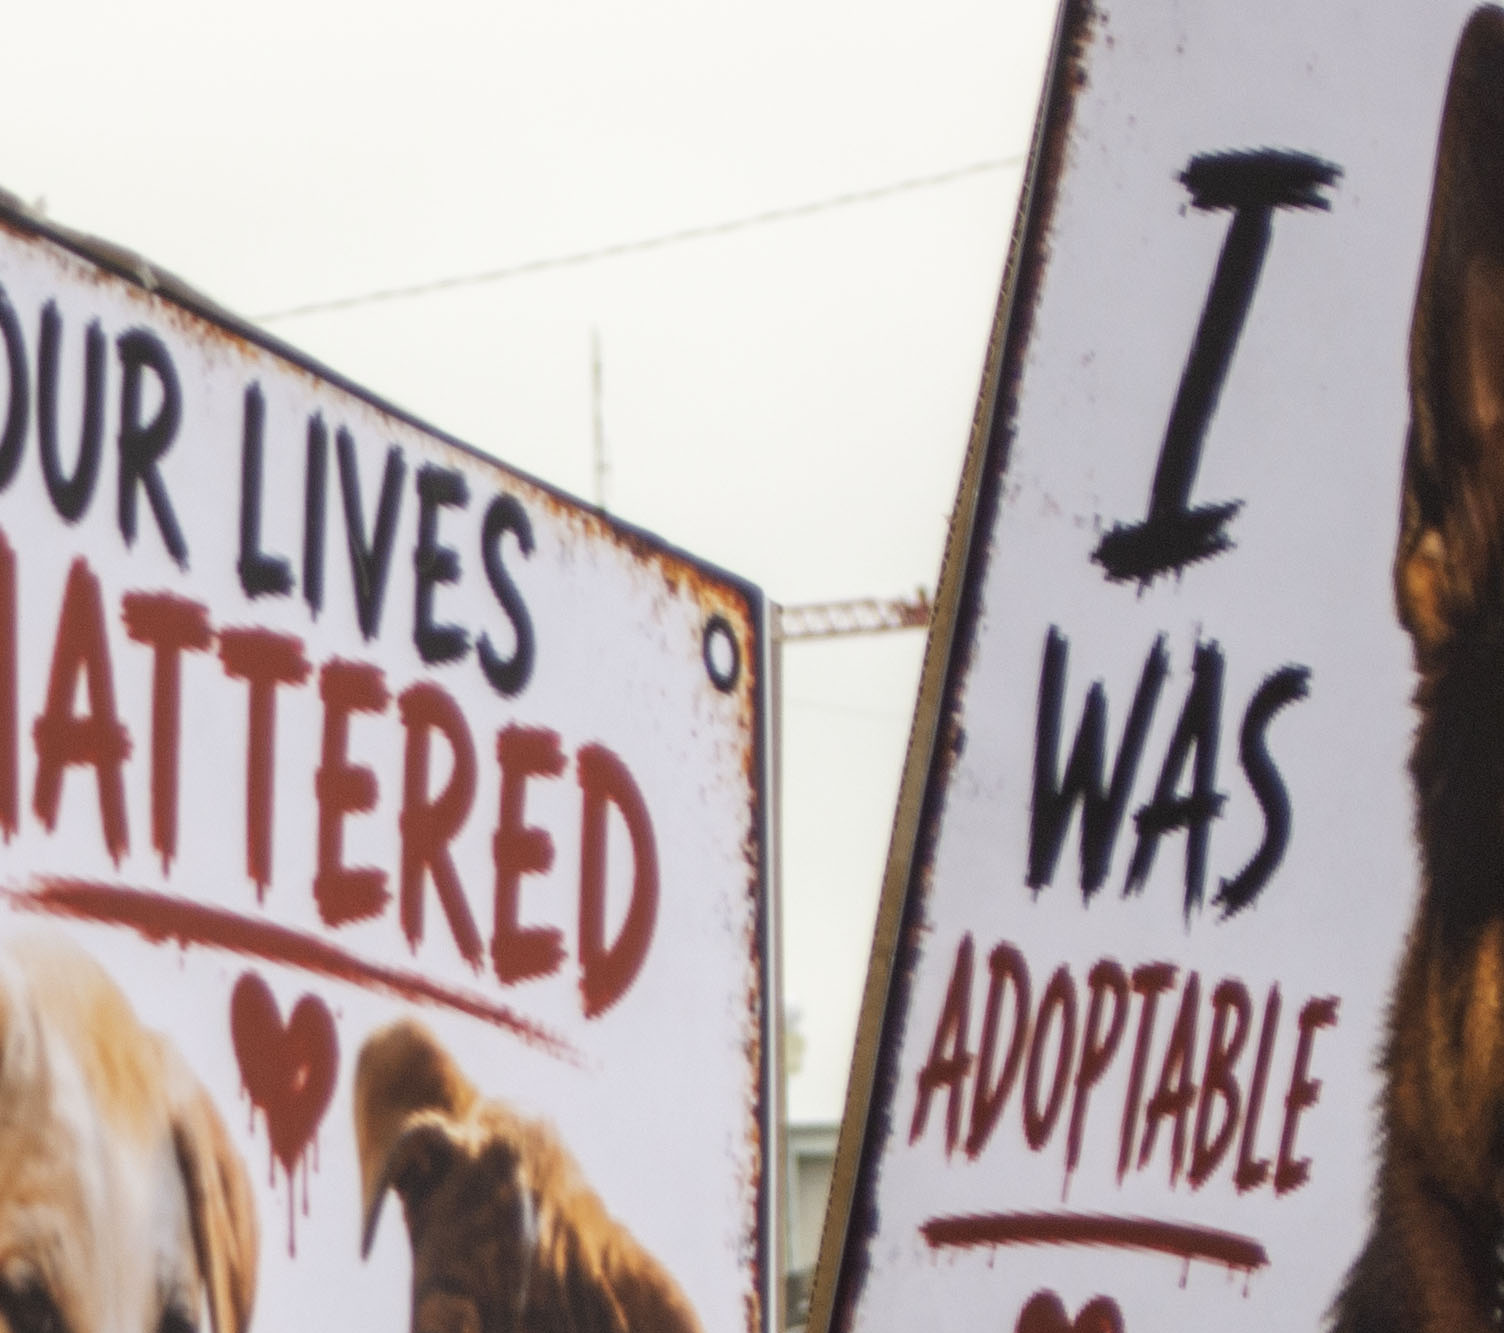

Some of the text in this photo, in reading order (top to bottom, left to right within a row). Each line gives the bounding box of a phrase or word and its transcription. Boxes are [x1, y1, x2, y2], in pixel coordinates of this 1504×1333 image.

[1090, 146, 1345, 598] I
[238, 380, 536, 698] LIVES
[1024, 622, 1314, 926] WAS
[908, 931, 1342, 1200] ADOPTABLE
